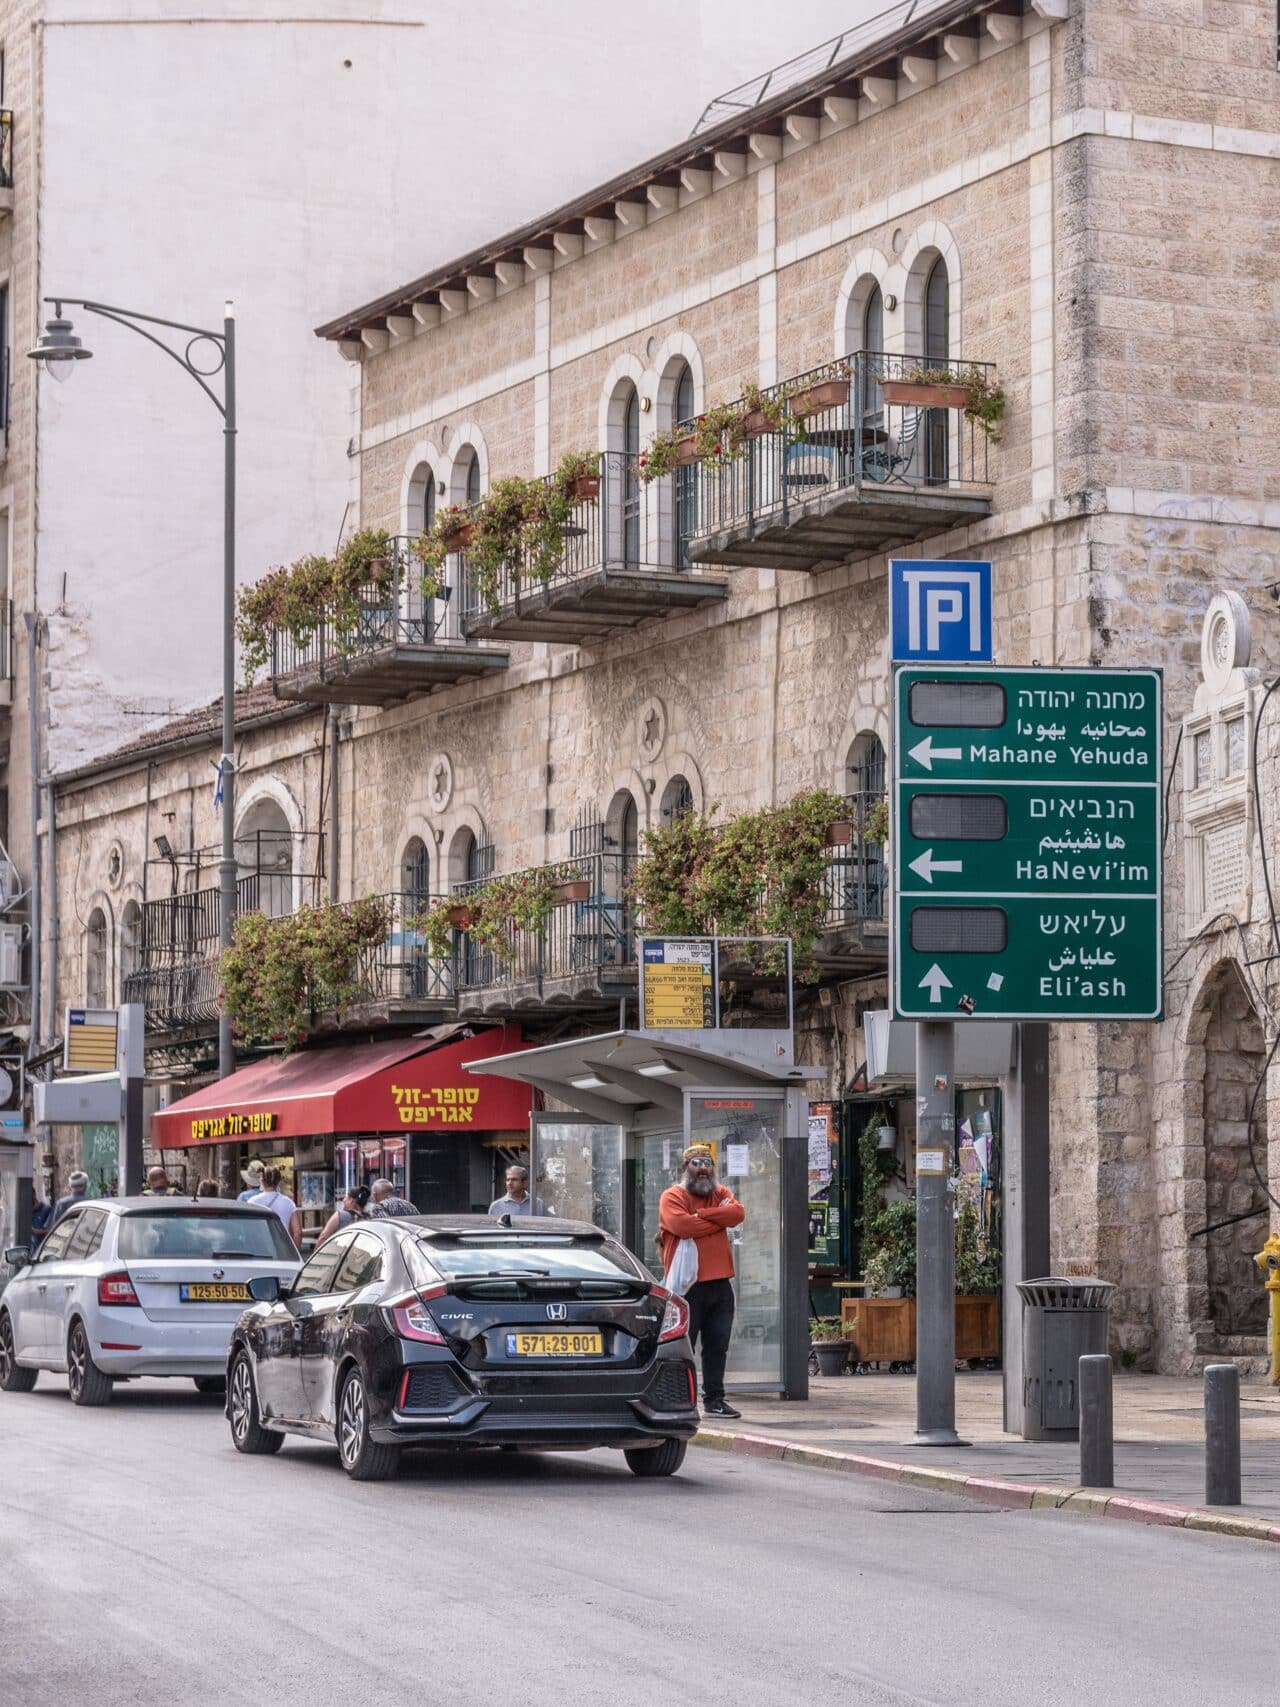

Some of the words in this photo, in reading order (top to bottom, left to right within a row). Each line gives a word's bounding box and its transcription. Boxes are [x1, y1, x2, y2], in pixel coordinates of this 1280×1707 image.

[1018, 689, 1075, 709] יהודה
[1085, 690, 1146, 710] מחנה
[1016, 718, 1067, 741] يهودا
[970, 745, 1057, 763] Mahane
[1070, 747, 1148, 766] Yehuda
[1030, 798, 1135, 819] הנביאים
[1016, 860, 1149, 882] HaNevi'im
[1040, 909, 1126, 937] עליאש
[1048, 947, 1117, 971] علياش
[1040, 978, 1127, 997] Eli'ash
[391, 1084, 480, 1105] סופר-זול
[229, 1112, 273, 1134] סופר-זול
[399, 1106, 473, 1123] אגריפס
[191, 1117, 226, 1139] אגריפס
